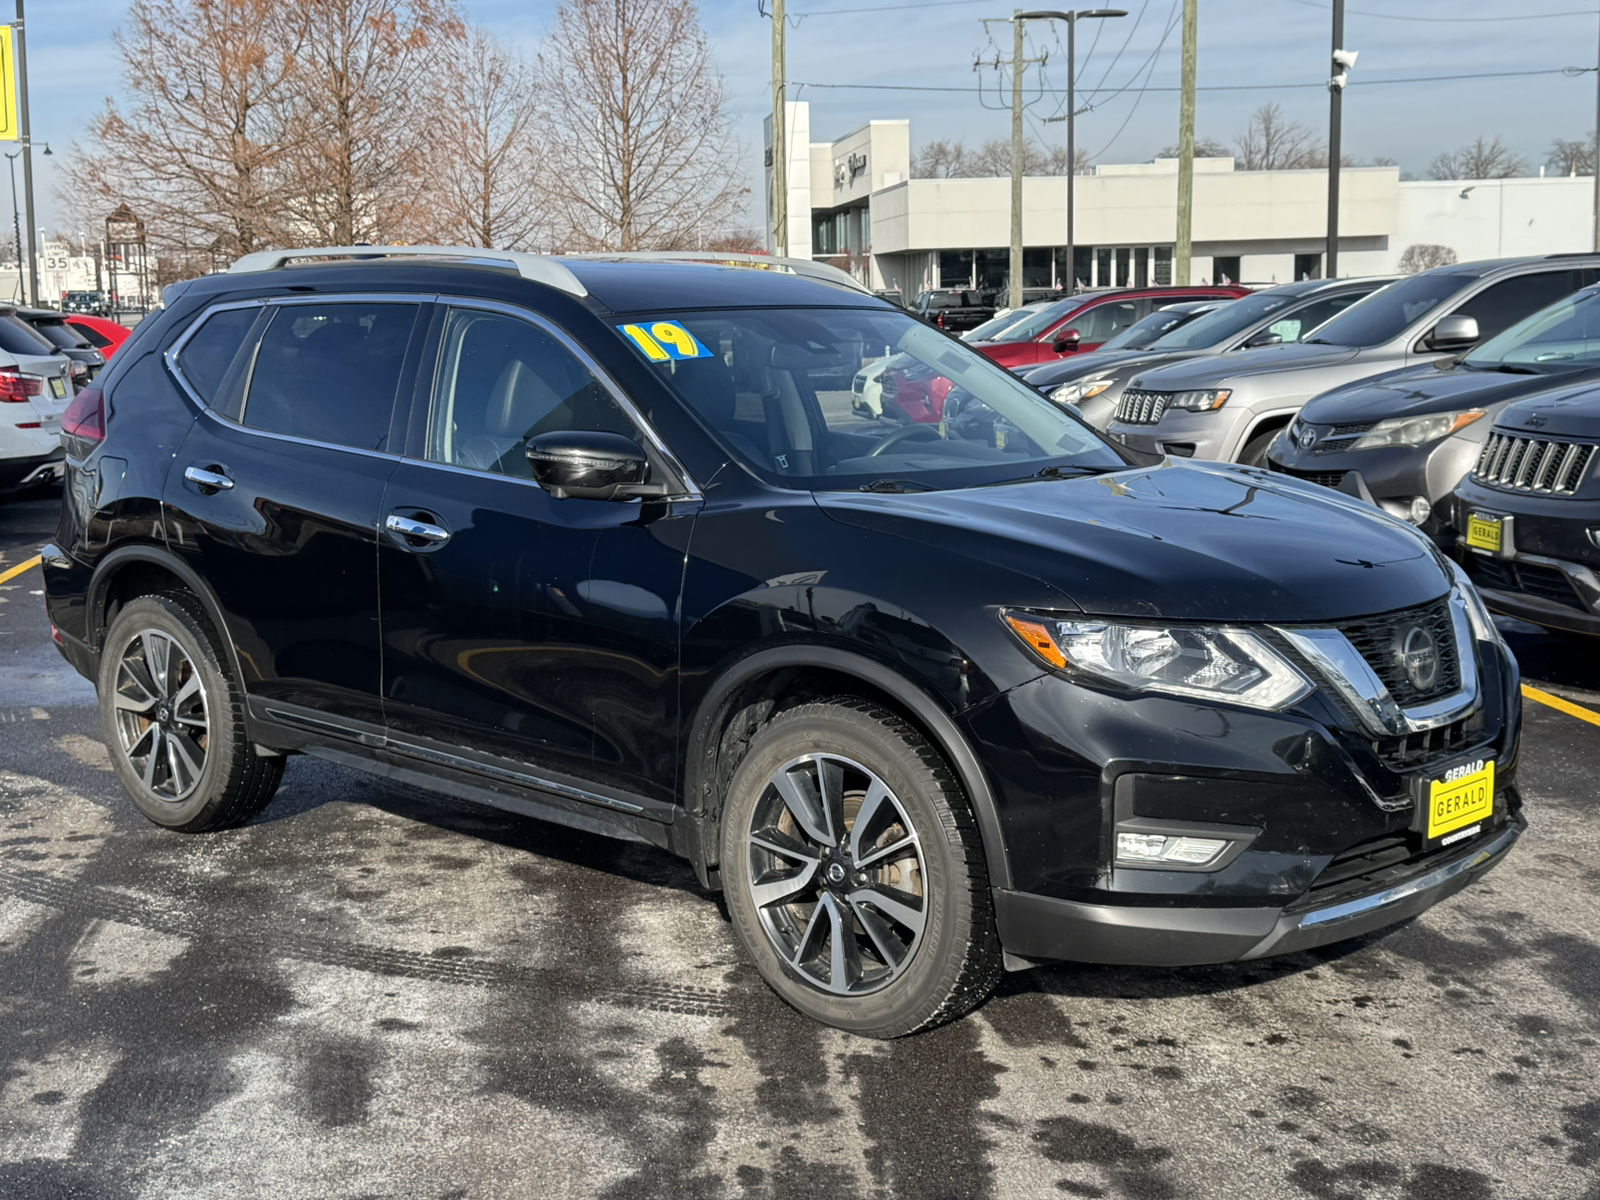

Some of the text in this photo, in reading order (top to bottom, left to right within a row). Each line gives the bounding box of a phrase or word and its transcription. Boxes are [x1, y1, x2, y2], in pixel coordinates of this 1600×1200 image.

[47, 257, 68, 269] 35
[624, 322, 699, 361] 19
[1474, 526, 1499, 541] GERALD
[1445, 759, 1484, 781] GERALD
[1437, 787, 1485, 817] GERALD
[726, 795, 740, 853] DEFENDER
[904, 793, 942, 889] MICHELIN
[726, 862, 759, 949] MICHELIN
[925, 899, 942, 961] 235/55R19
